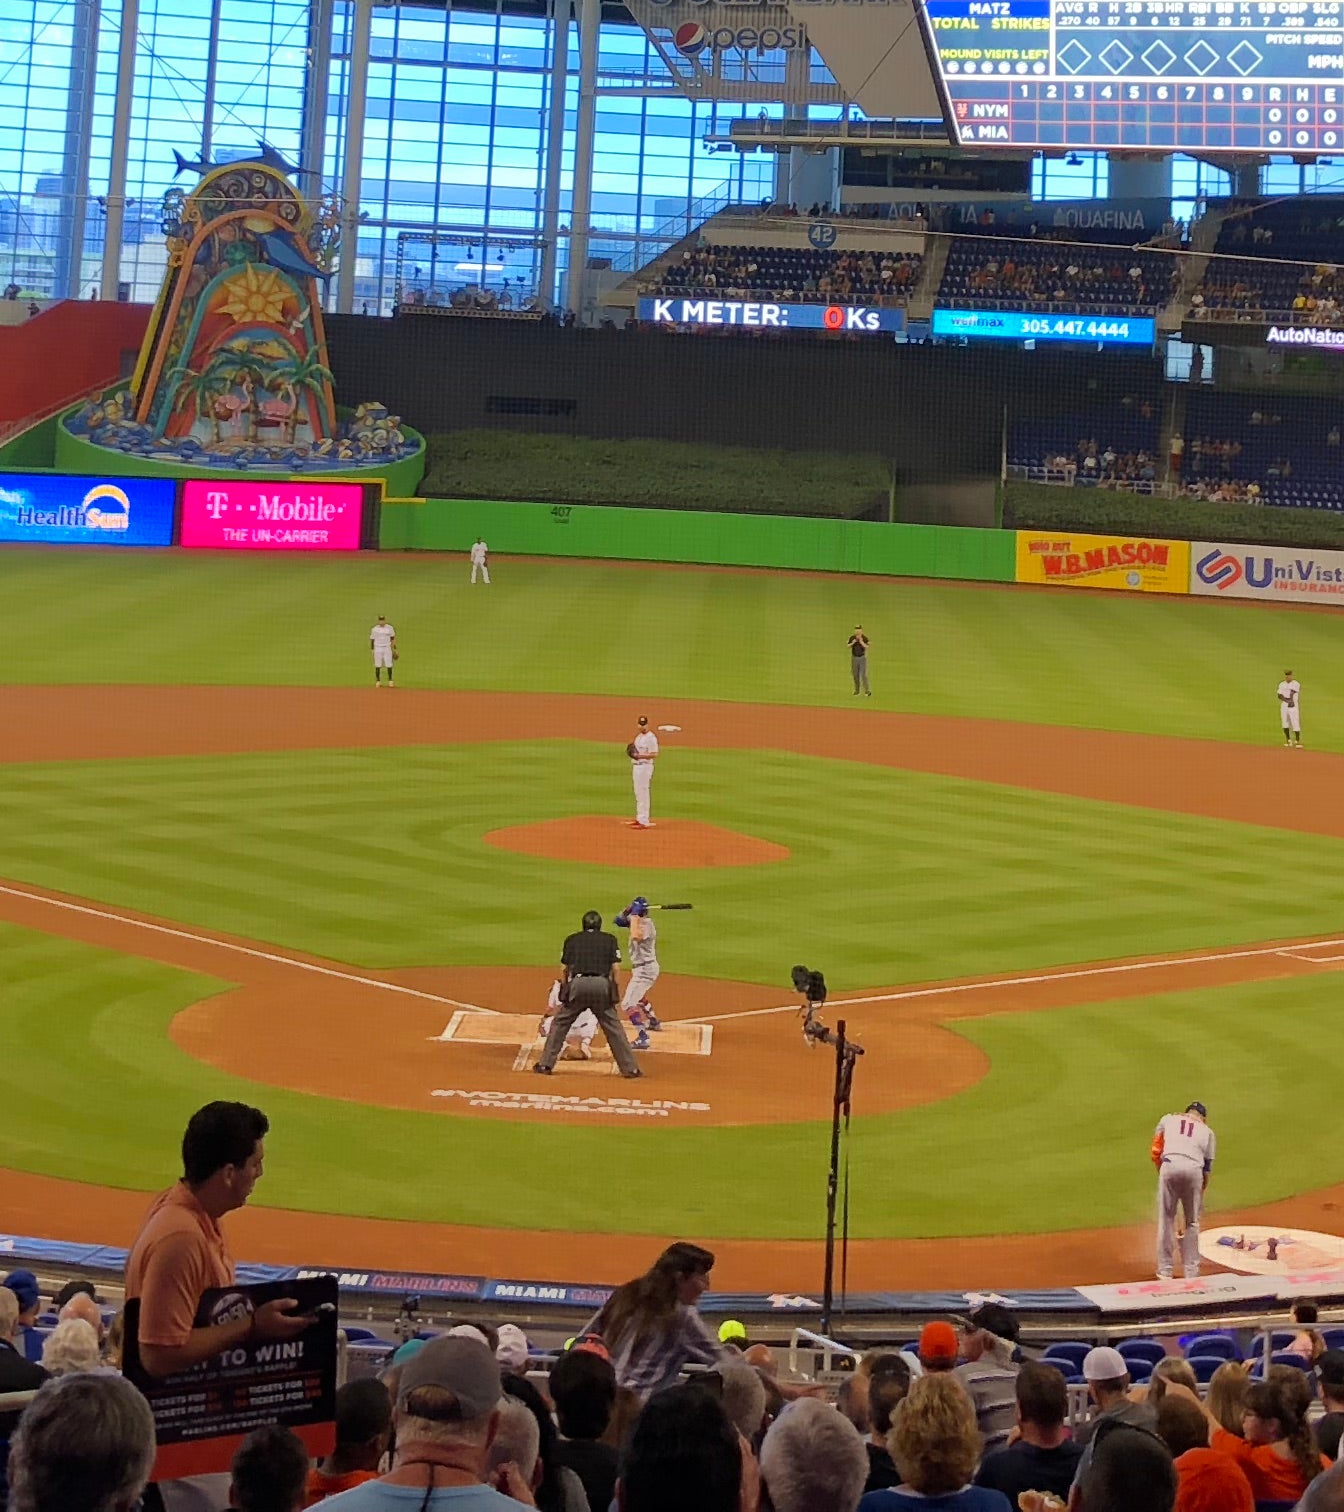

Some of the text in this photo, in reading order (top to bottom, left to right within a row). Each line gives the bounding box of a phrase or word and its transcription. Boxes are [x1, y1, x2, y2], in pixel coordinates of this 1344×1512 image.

[969, 2, 1010, 15] MATZ
[932, 17, 1050, 30] TOTAL STRIKES
[710, 24, 808, 55] pepsi
[1265, 34, 1343, 46] PITCH SPEED
[940, 49, 1049, 59] MOUND VISITS LEFT
[1308, 55, 1344, 69] MPH
[973, 104, 1009, 117] NYM
[979, 125, 1008, 138] MIA
[811, 226, 833, 243] 42
[654, 299, 880, 330] K METER: 0 Ks
[1021, 319, 1129, 337] 305.447.4444
[223, 528, 328, 543] THE UN-CARRIER
[431, 1089, 711, 1111] #VOTEMARLINS
[469, 1099, 669, 1117] marlins.com
[1180, 1120, 1194, 1138] 11
[495, 1284, 567, 1300] MIAMI
[219, 1341, 304, 1367] TO WIN!
[249, 1382, 283, 1394] TICKETS
[249, 1393, 284, 1405] TICKETS
